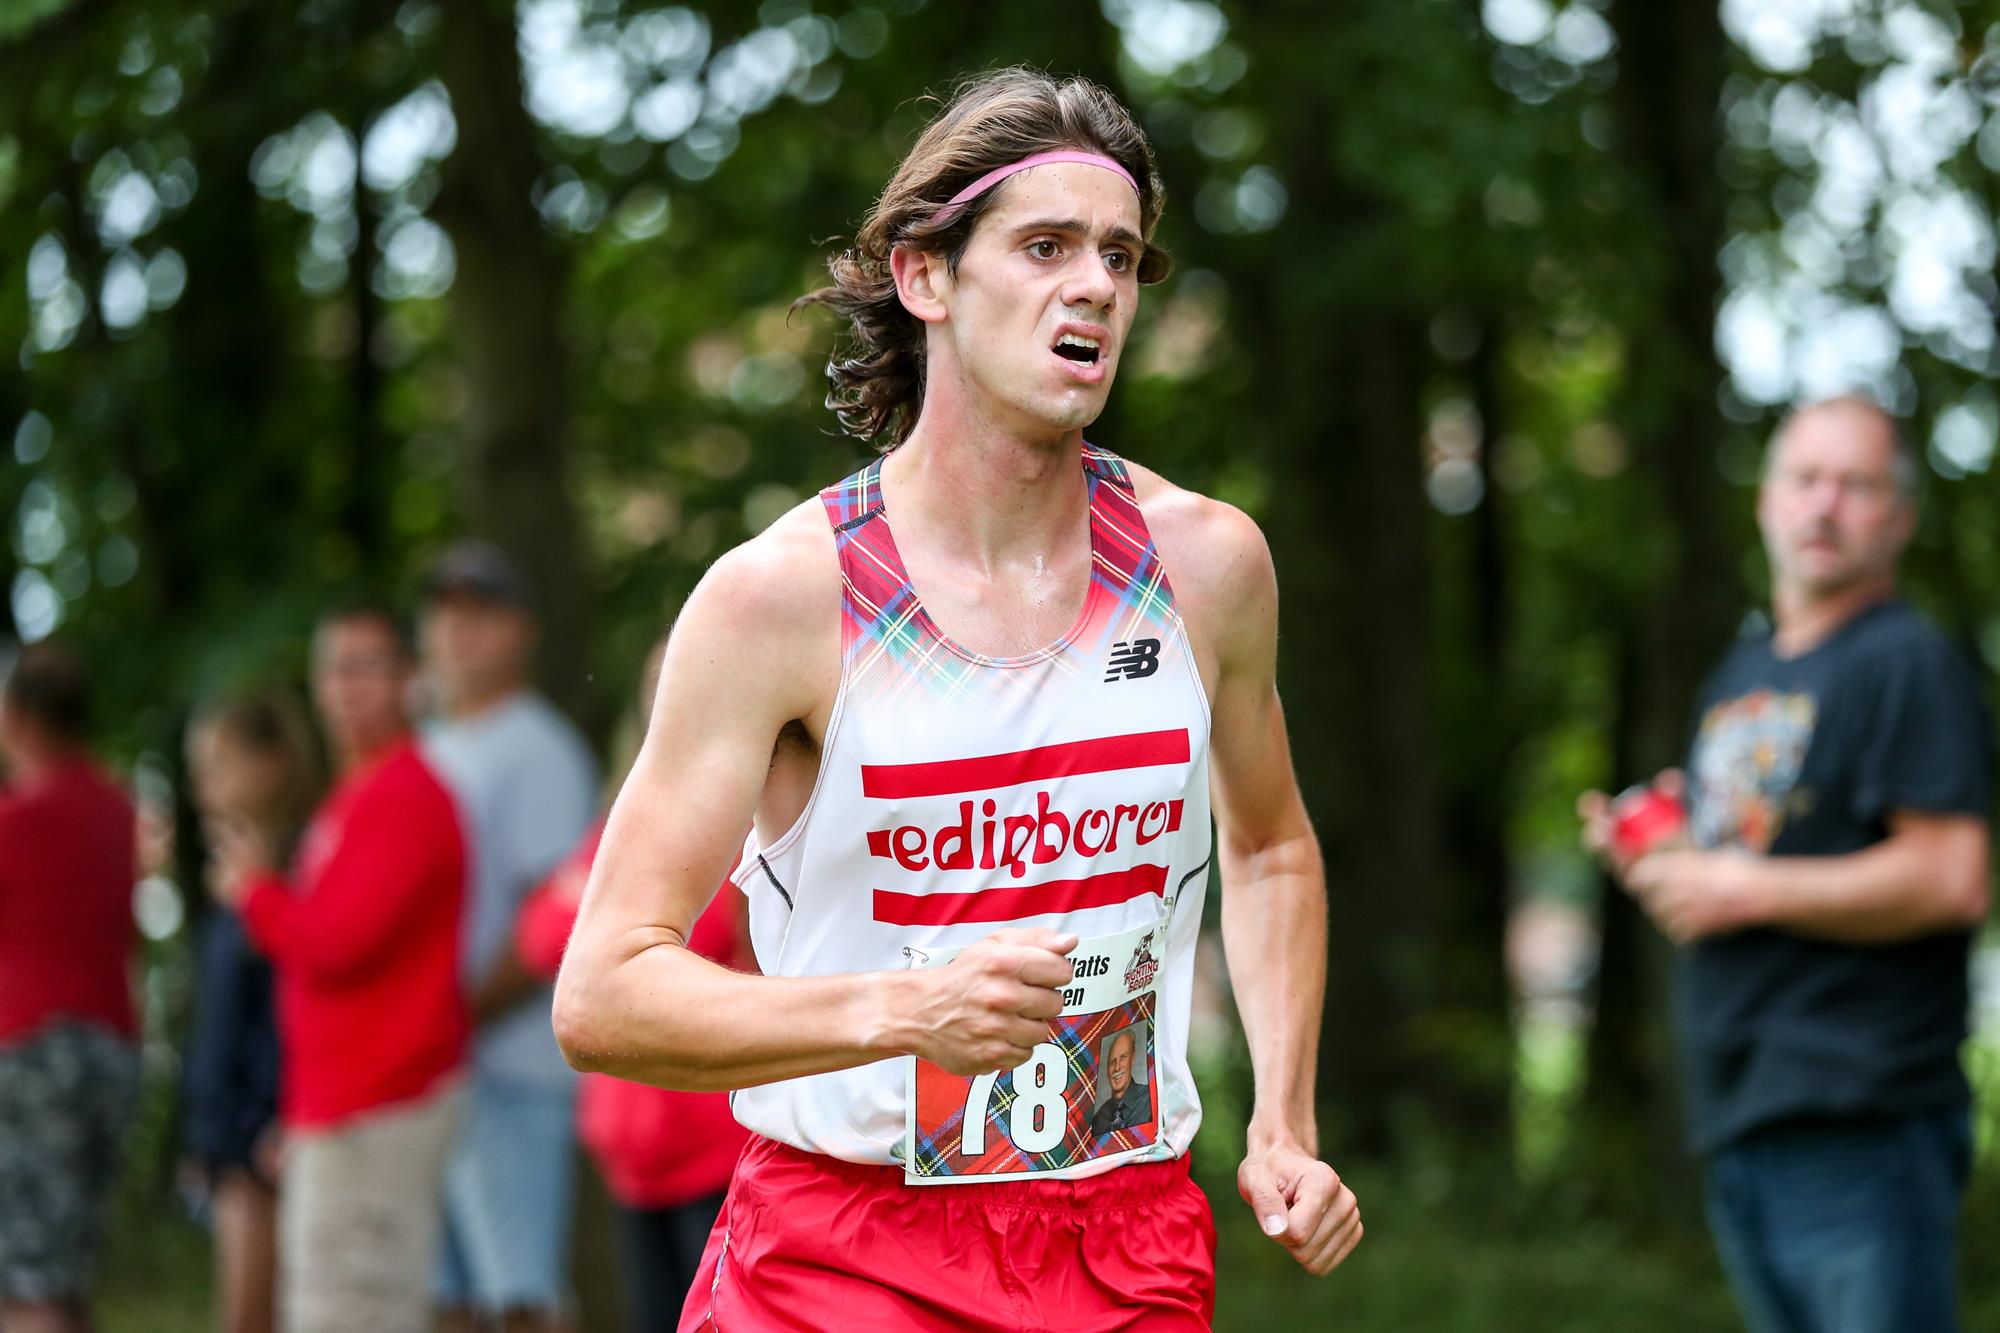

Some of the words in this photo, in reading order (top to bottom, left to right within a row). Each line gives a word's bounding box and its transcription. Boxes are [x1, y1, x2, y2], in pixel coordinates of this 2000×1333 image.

[1104, 638, 1161, 683] NB
[892, 791, 1167, 878] edinboro
[1068, 955, 1110, 978] atts
